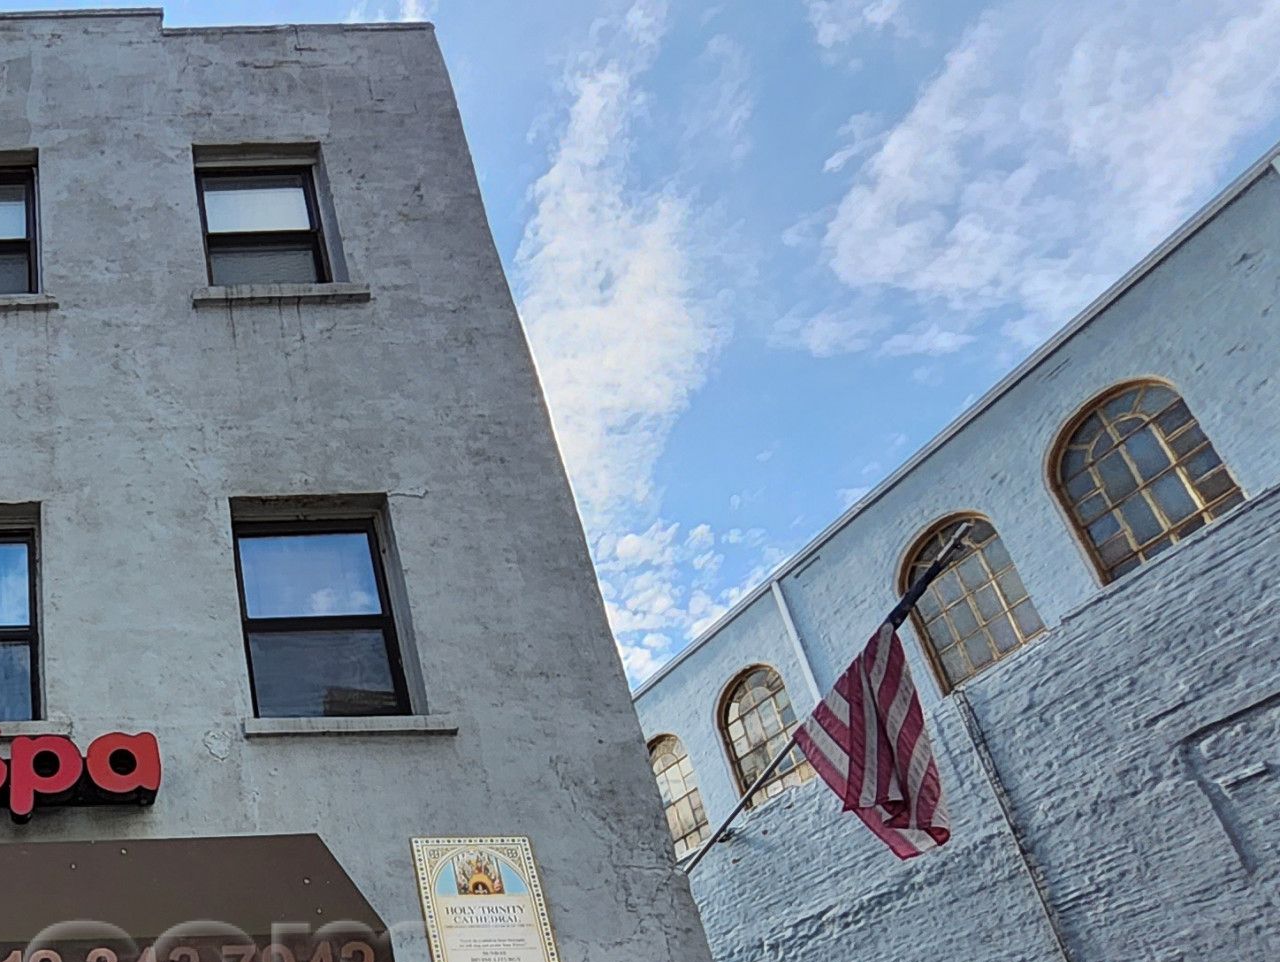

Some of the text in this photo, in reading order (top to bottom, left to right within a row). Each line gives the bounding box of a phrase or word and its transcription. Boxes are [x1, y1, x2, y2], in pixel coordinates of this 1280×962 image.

[445, 904, 526, 915] HOLY TRINITY
[453, 915, 521, 924] CATHEDRAL
